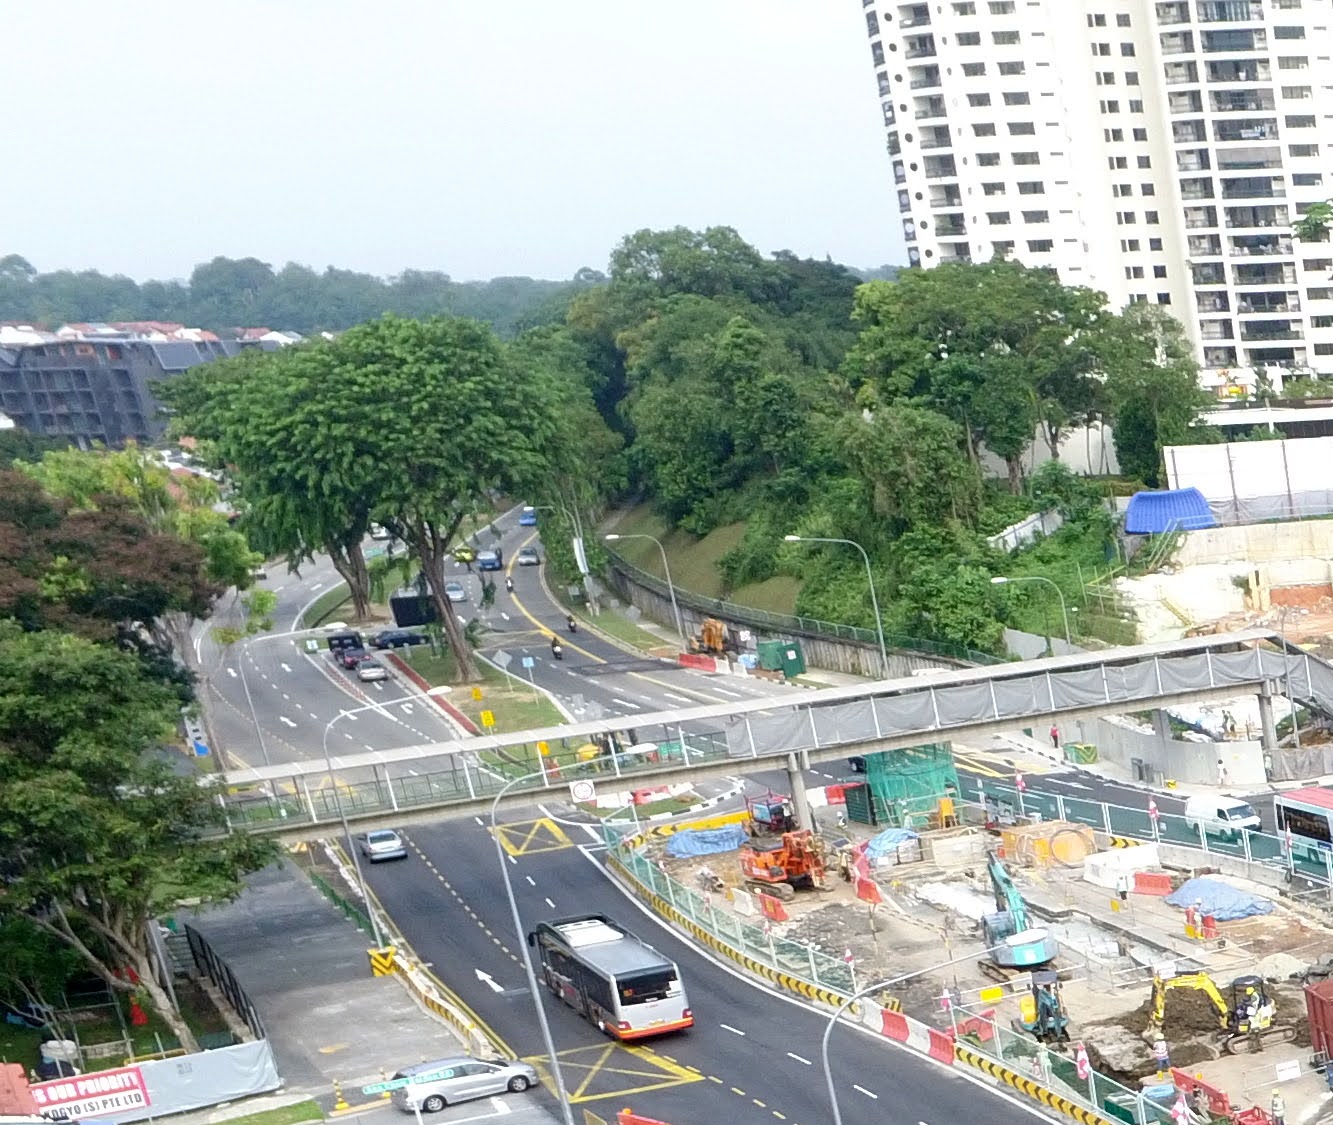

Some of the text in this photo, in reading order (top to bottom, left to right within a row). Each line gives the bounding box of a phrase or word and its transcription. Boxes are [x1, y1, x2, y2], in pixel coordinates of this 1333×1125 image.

[47, 1083, 77, 1101] OUR
[77, 1071, 139, 1096] PRIORITY
[102, 1097, 121, 1109] PTE
[123, 1093, 142, 1105] LTD
